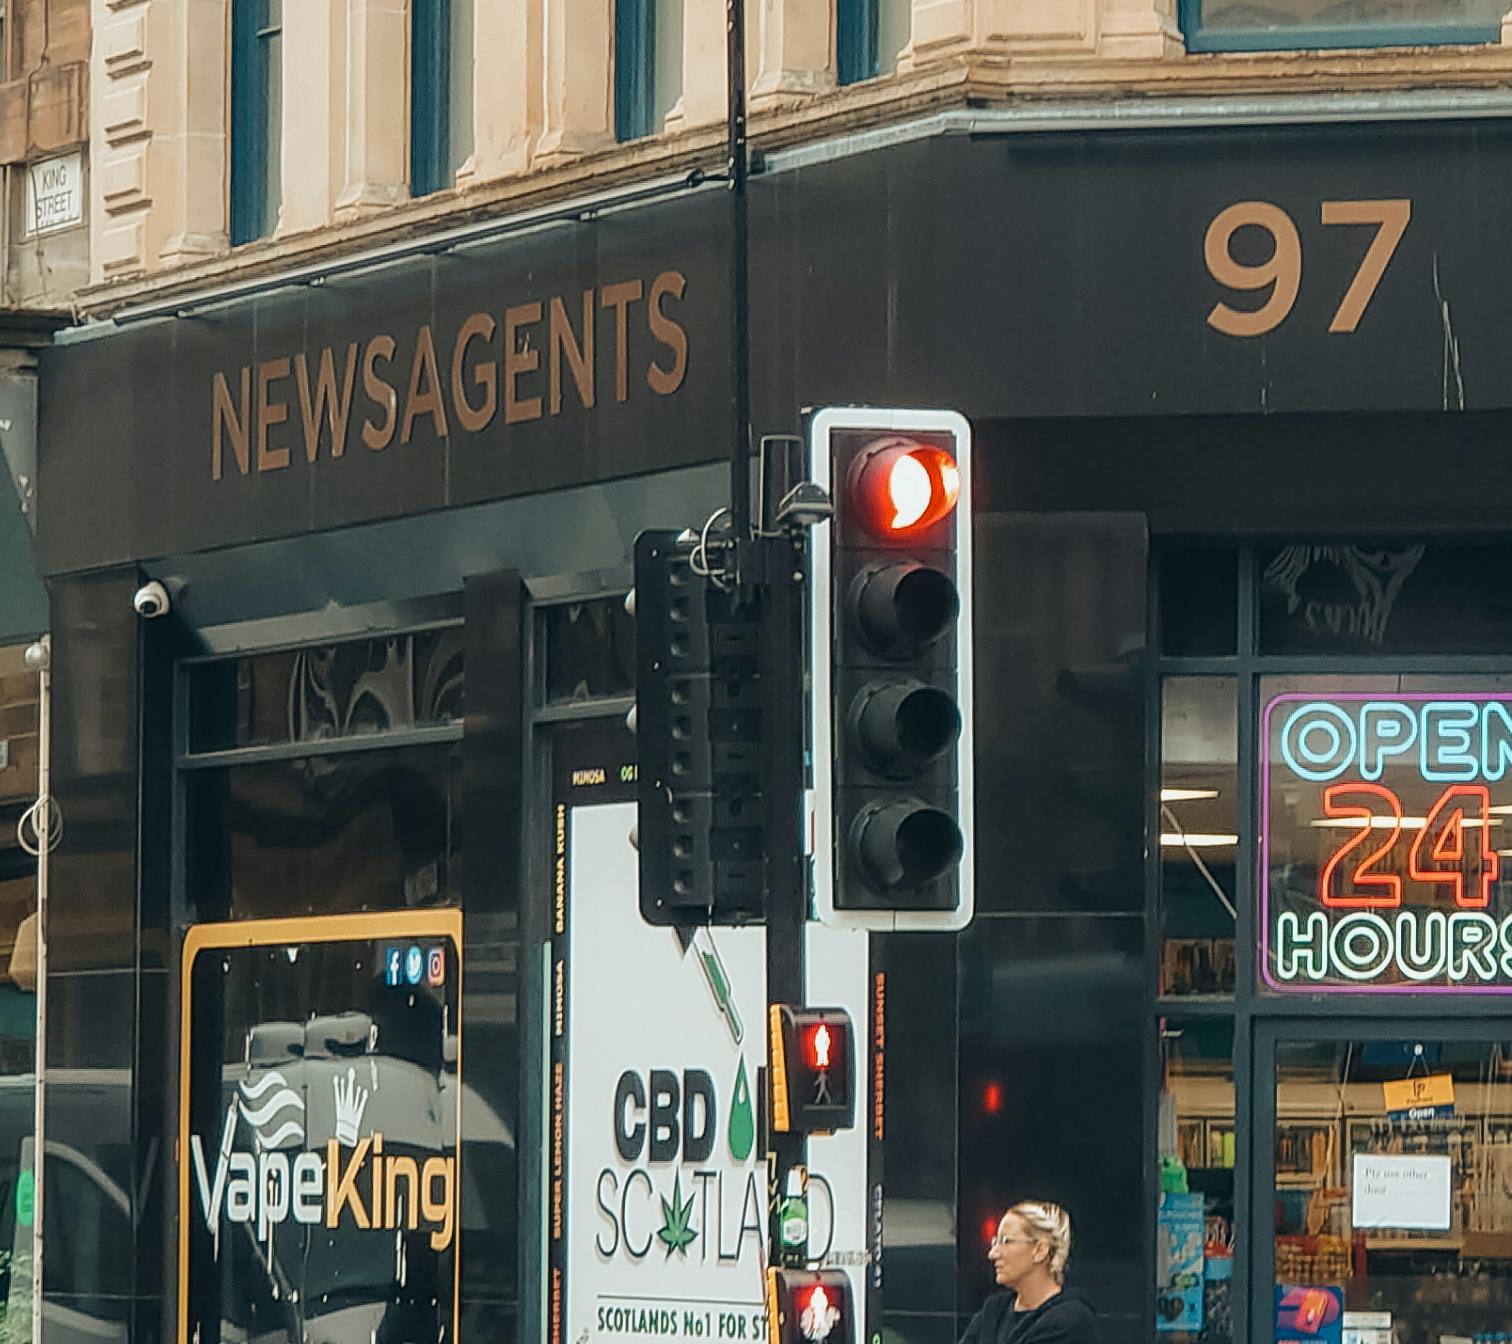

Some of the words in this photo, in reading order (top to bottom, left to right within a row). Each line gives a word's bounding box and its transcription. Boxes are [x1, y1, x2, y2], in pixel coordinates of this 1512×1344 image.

[36, 190, 72, 219] STREET
[42, 165, 67, 187] KING
[1204, 199, 1411, 336] 97
[212, 270, 689, 481] NEWSAGENTS
[1320, 783, 1500, 908] 24
[556, 857, 565, 933] BANANA
[614, 1068, 717, 1162] CBD
[191, 1131, 455, 1252] VapeKing
[596, 1168, 834, 1262] SCTLAD
[598, 1306, 677, 1336] SCOTLANDS
[684, 1311, 711, 1338] No1
[719, 1313, 746, 1340] FOR
